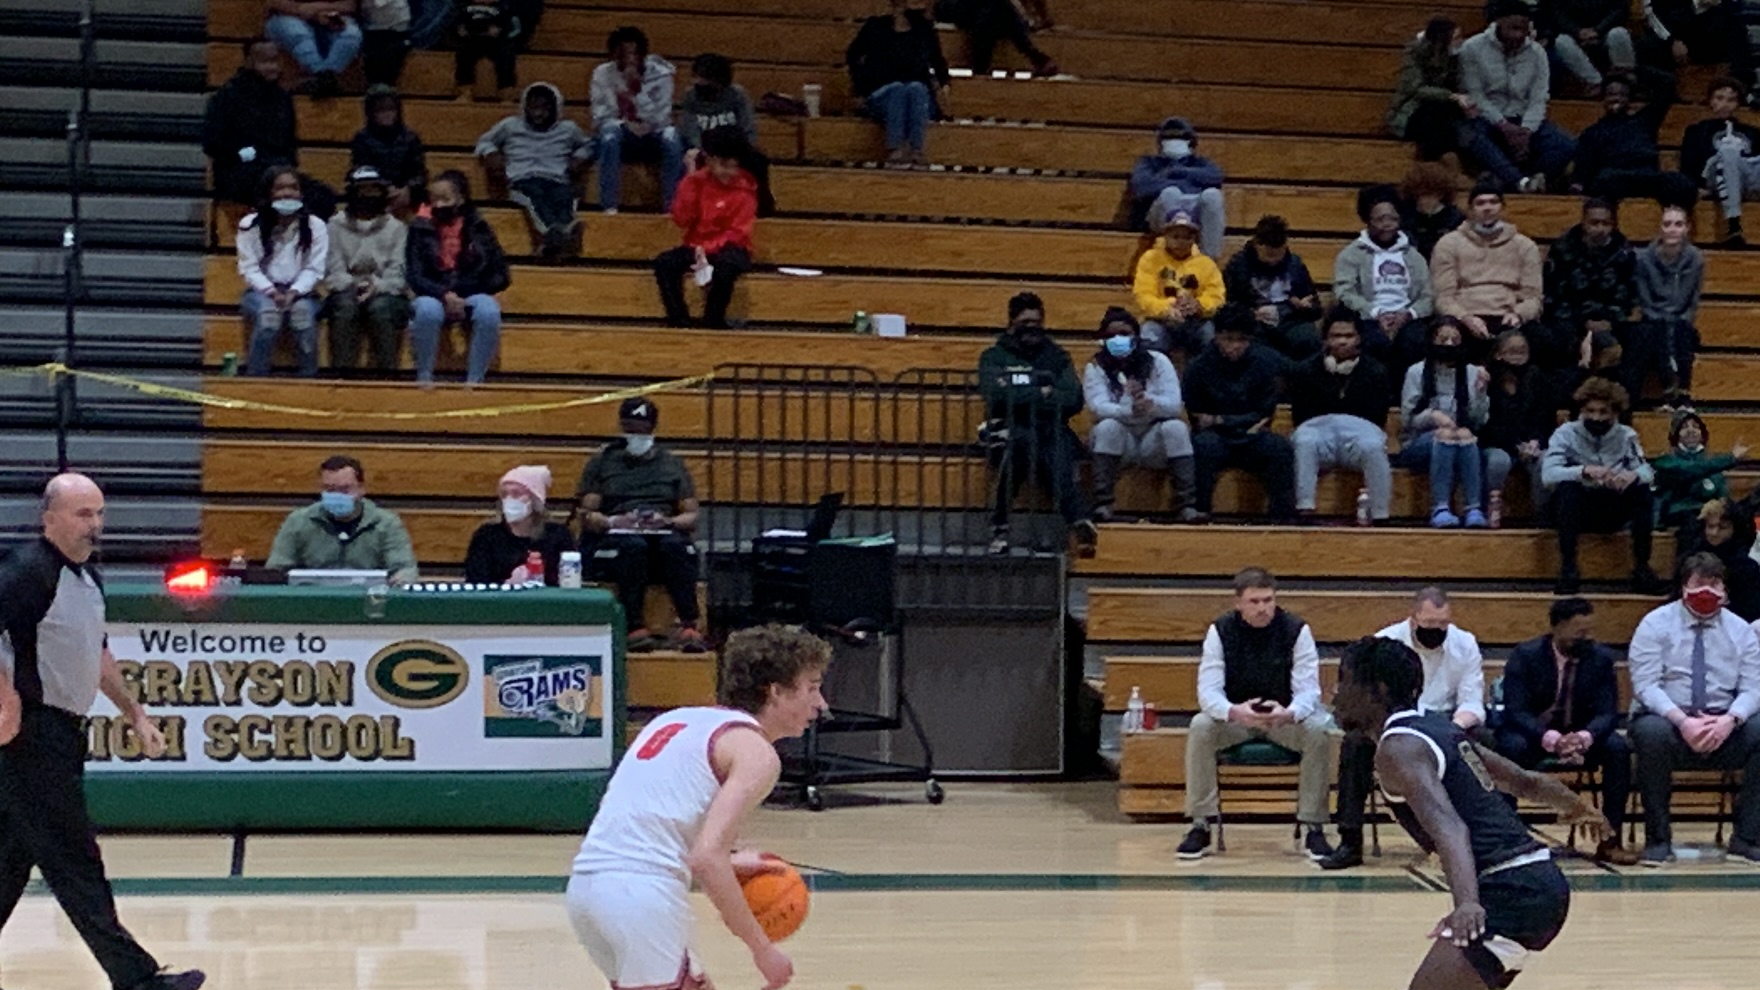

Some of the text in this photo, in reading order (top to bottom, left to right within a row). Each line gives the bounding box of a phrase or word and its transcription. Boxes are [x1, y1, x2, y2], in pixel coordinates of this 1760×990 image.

[139, 628, 328, 653] Welcome to
[115, 659, 356, 707] GRAYSON
[374, 648, 463, 701] G
[498, 668, 587, 709] RAMS
[80, 714, 415, 762] IGH SCHOOL
